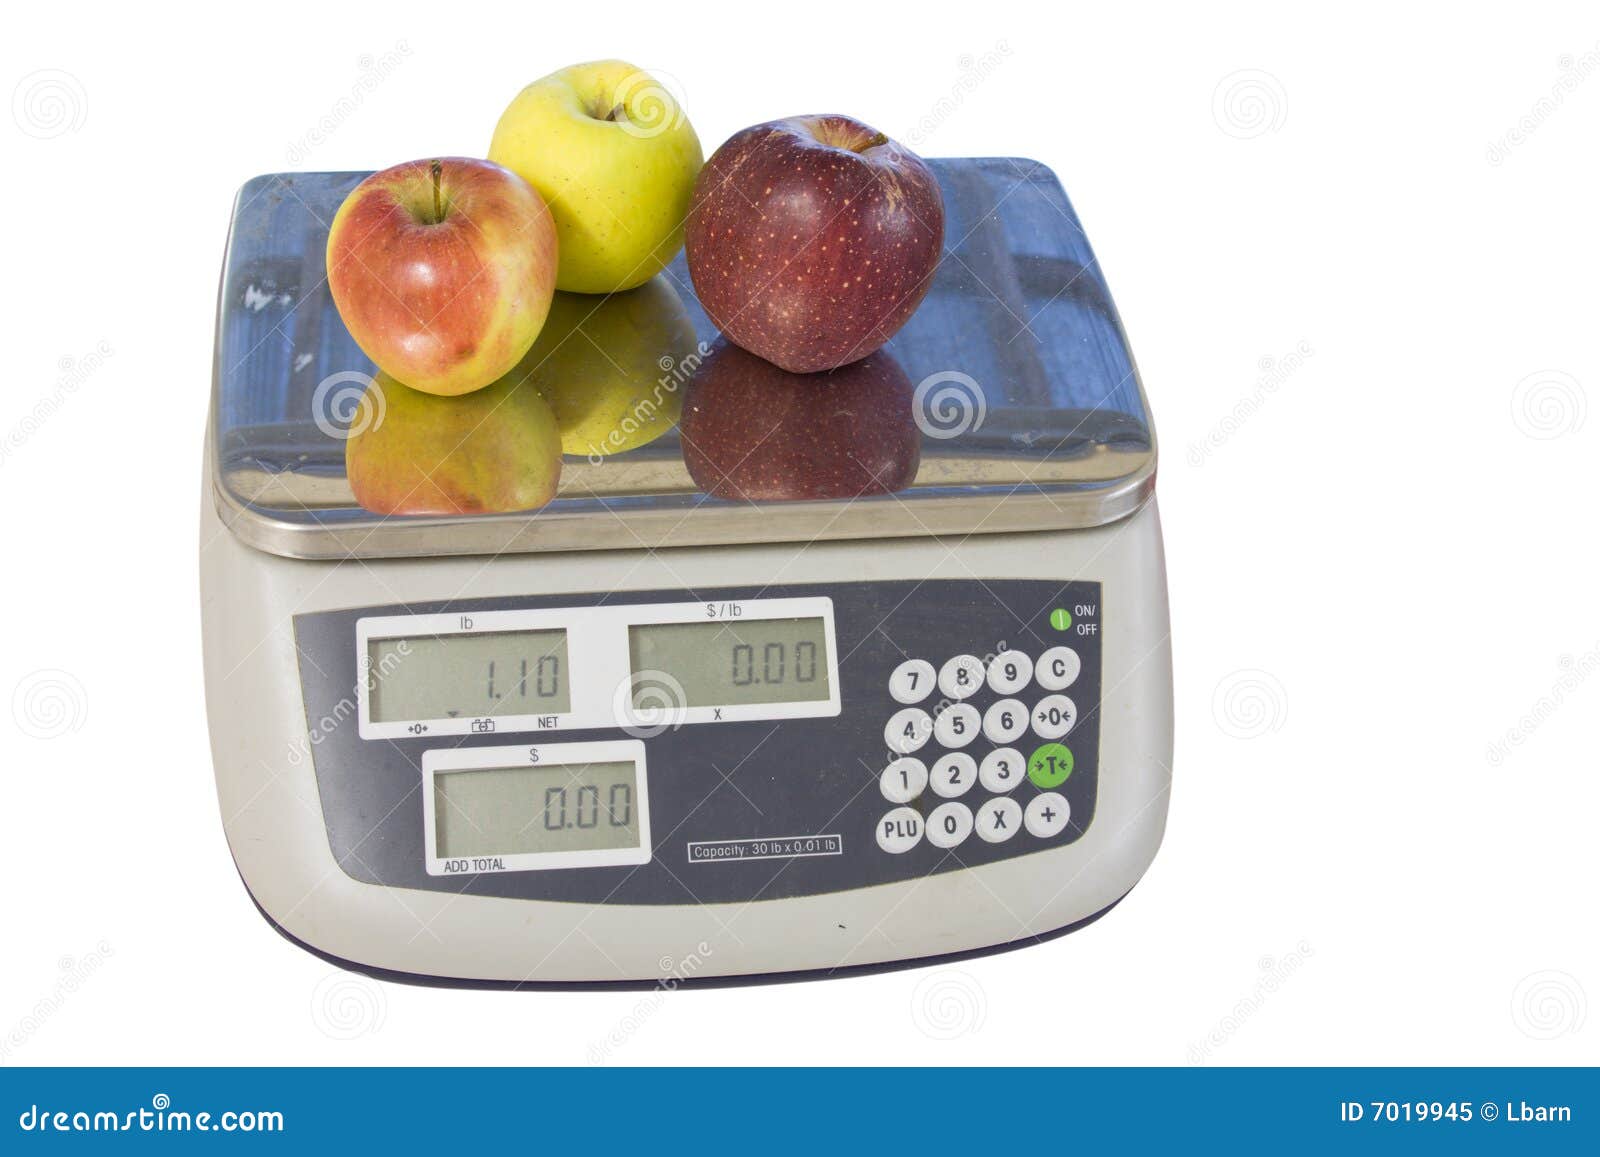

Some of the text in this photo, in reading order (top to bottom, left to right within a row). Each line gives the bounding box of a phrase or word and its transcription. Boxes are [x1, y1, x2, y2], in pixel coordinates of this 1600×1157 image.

[707, 603, 716, 618] $
[729, 602, 742, 617] lb
[1075, 604, 1096, 617] ON/
[460, 616, 473, 630] lb
[1077, 624, 1097, 636] OFF
[732, 641, 816, 686] 0.00
[488, 655, 559, 699] 1.10
[907, 659, 1065, 690] 7 8 9 C
[538, 716, 558, 729] NET
[714, 708, 722, 721] X
[903, 720, 916, 740] 4
[952, 716, 965, 735] 5
[1001, 711, 1014, 730] 6
[529, 748, 539, 763] $
[900, 771, 909, 790] 1
[948, 765, 961, 784] 2
[997, 761, 1010, 779] 3
[544, 783, 631, 830] 0.00
[884, 820, 917, 838] PLU
[944, 815, 957, 834] 0
[993, 810, 1007, 829] X
[694, 839, 836, 859] Capacity: 30 lb x 0.01 lb
[444, 858, 506, 873] ADD TOTAL
